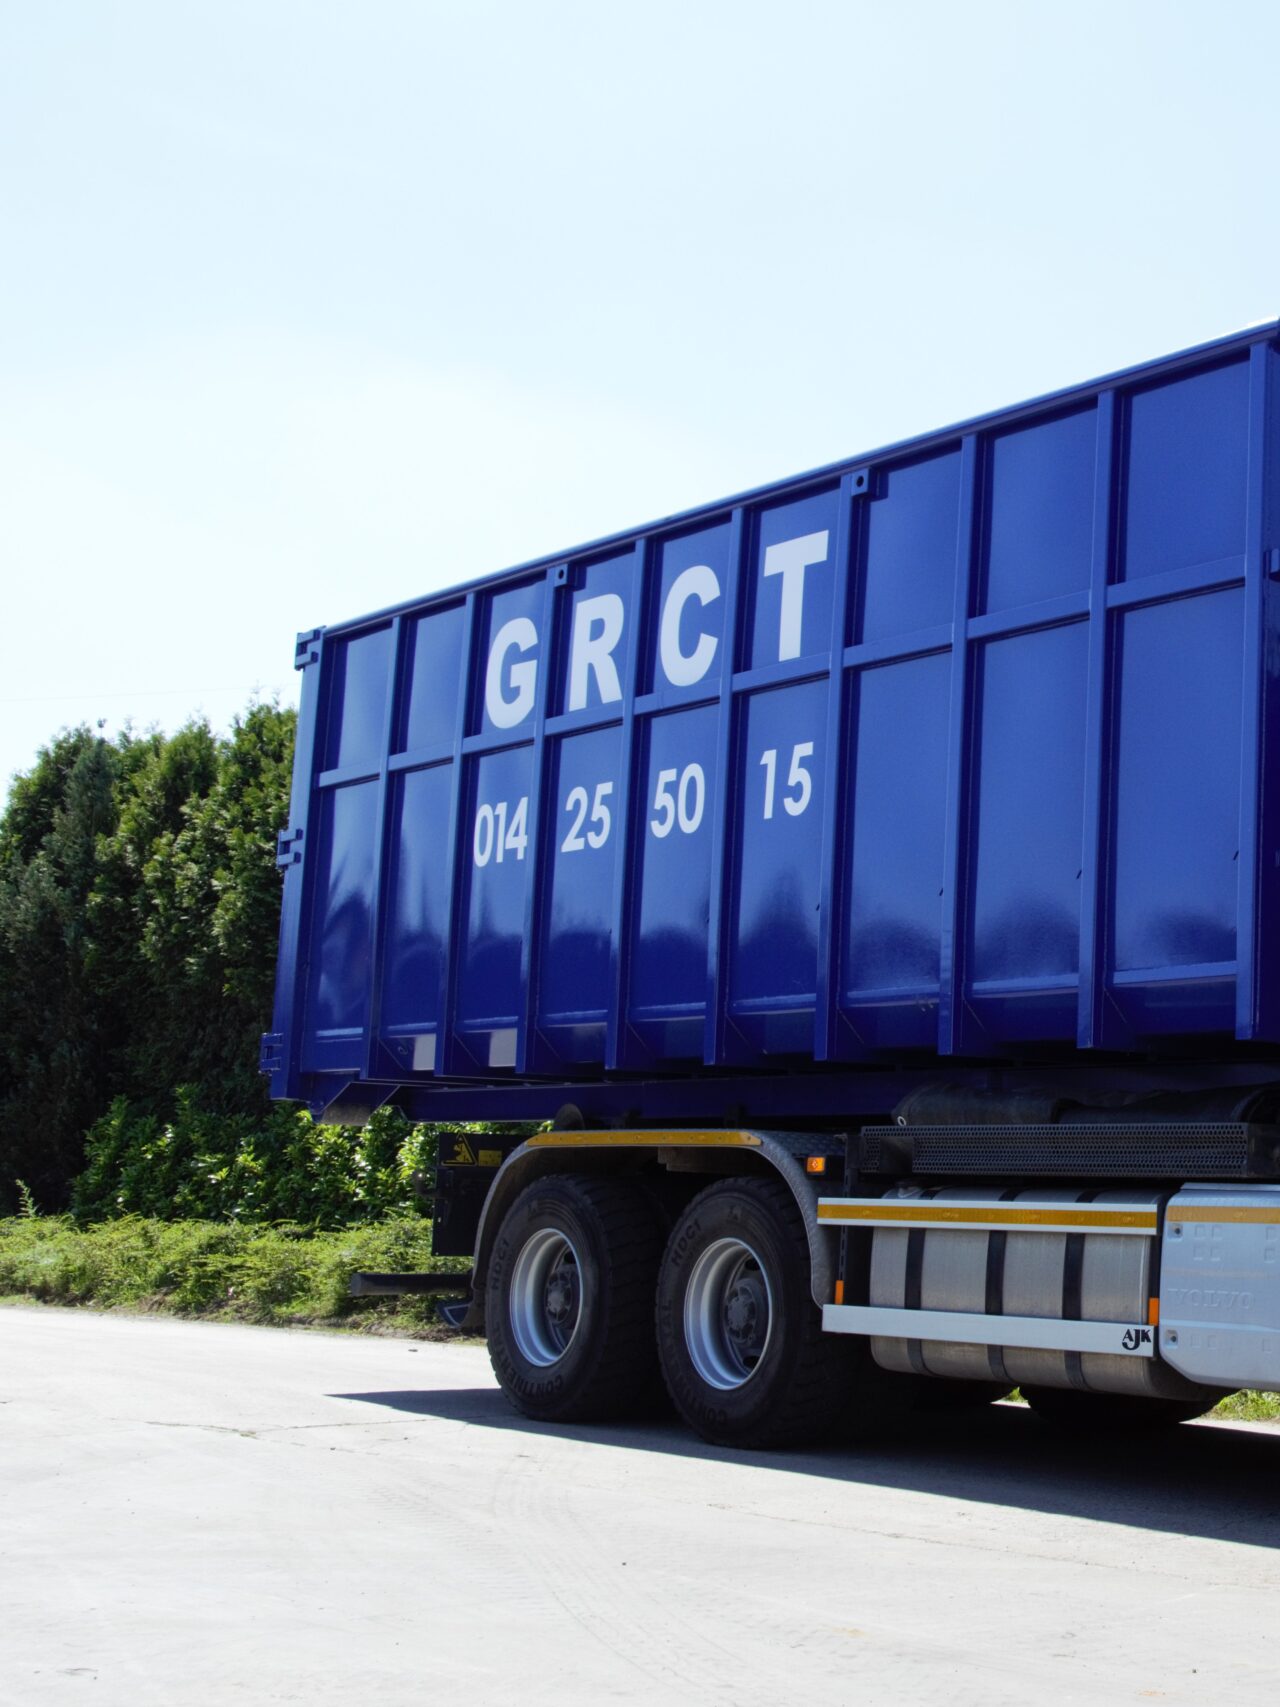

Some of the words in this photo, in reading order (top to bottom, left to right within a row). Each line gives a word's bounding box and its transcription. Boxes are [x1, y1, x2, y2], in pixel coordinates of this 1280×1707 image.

[485, 530, 829, 729] GRCT
[473, 797, 529, 867] 014
[561, 781, 613, 853] 25
[650, 763, 705, 838] 50
[759, 742, 814, 820] 15
[1167, 1288, 1255, 1310] VOLVO
[1122, 1329, 1151, 1351] AJK
